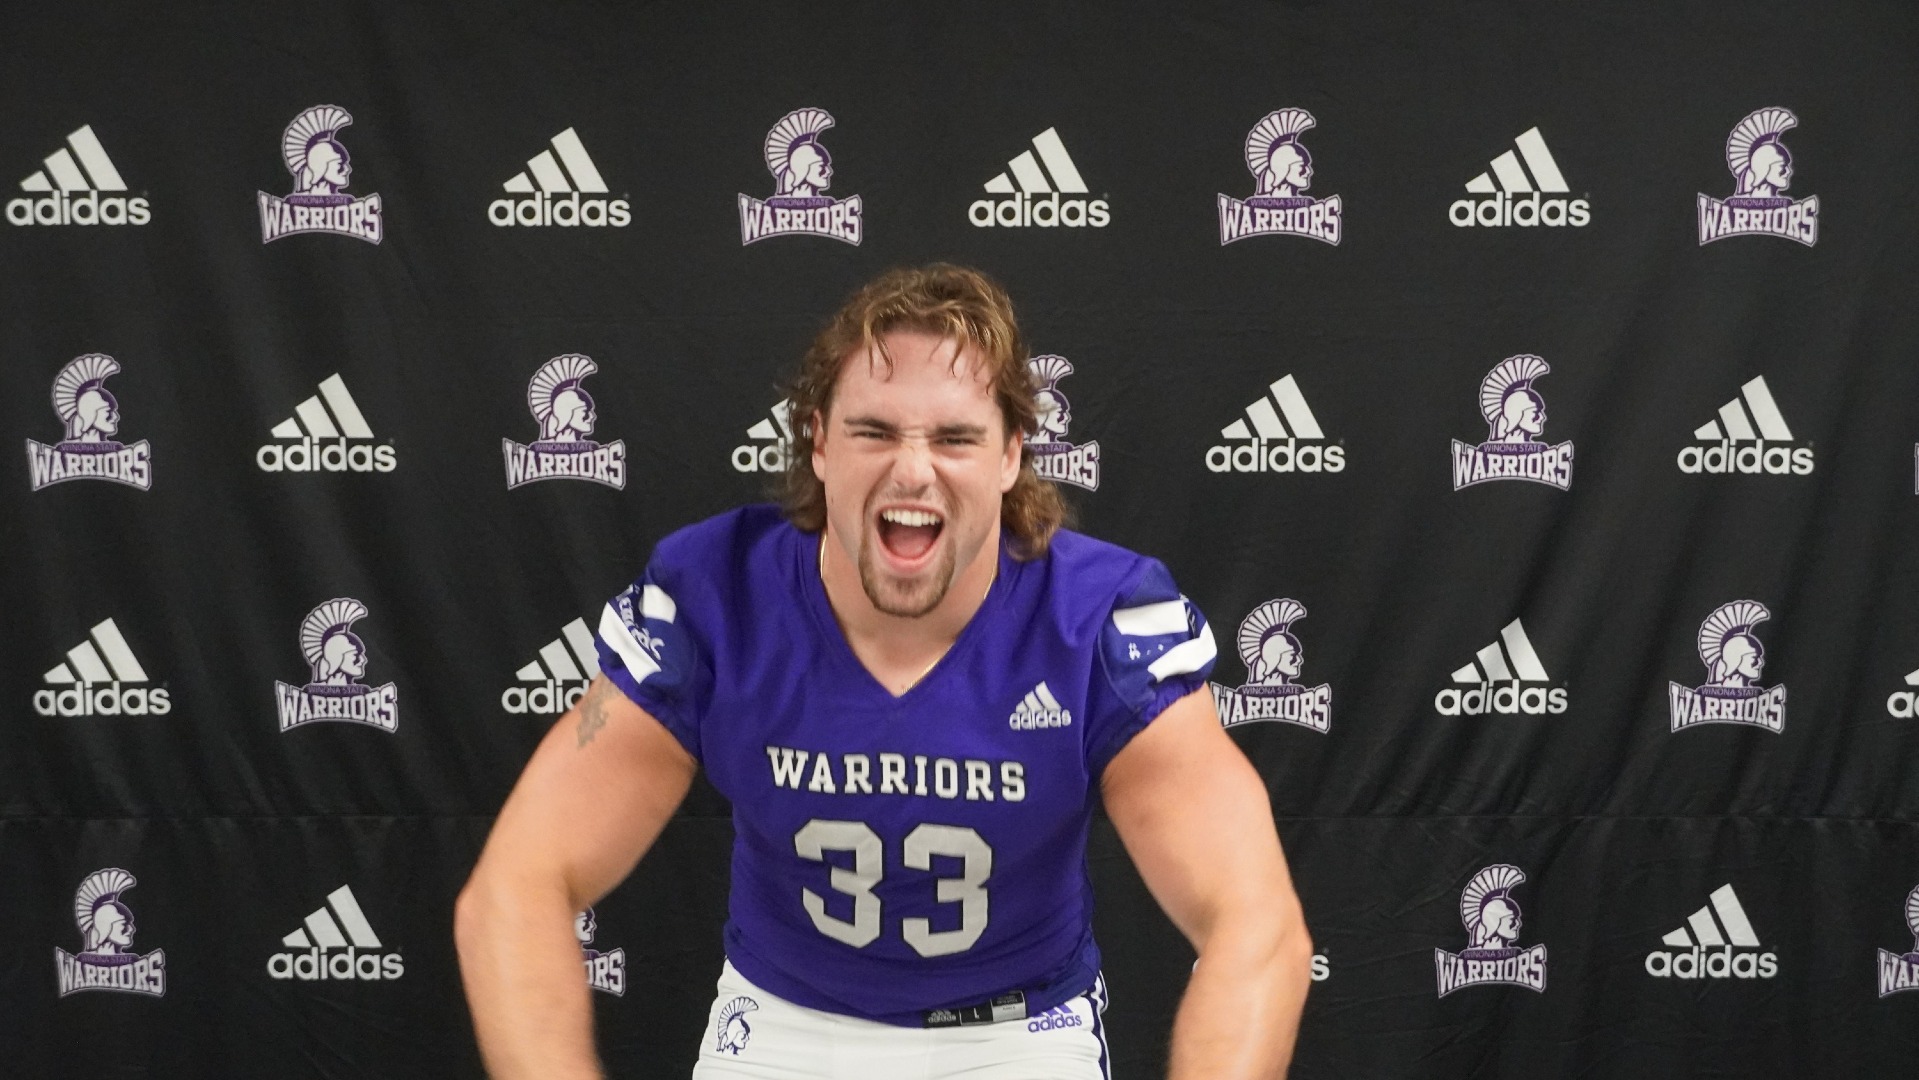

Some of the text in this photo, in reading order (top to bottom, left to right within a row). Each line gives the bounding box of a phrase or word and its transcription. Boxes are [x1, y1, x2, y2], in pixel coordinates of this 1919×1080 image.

[6, 190, 150, 225] adidas
[260, 194, 380, 241] WARRIORS
[290, 197, 348, 205] WINONA STATE
[488, 191, 631, 226] adidas
[771, 199, 829, 207] WINONA STATE
[969, 191, 1110, 227] adidas
[1250, 199, 1310, 207] WINONA STATE
[1449, 192, 1590, 227] adidas
[1730, 198, 1788, 207] WINONA STATE
[740, 196, 860, 243] WARRIORS
[1220, 196, 1340, 243] WARRIORS
[1699, 196, 1817, 243] WARRIORS
[30, 442, 149, 487] WARRIORS
[61, 443, 118, 452] WINONA STATE
[257, 437, 396, 472] adidas
[505, 441, 623, 487] WARRIORS
[536, 443, 593, 451] WINONA STATE
[1206, 438, 1345, 472] adidas
[1454, 442, 1571, 487] WARRIORS
[1483, 444, 1542, 453] WINONA STATE
[1677, 440, 1813, 475] adidas
[1032, 444, 1096, 487] RIORS
[34, 681, 171, 716] adidas
[277, 683, 396, 730] WARRIORS
[1212, 685, 1328, 730] WARRIORS
[1242, 686, 1299, 695] WINONA STATE
[1435, 680, 1567, 715] adidas
[1671, 685, 1784, 730] WARRIORS
[1701, 687, 1758, 696] WINONA STATE
[1009, 709, 1071, 731] adidas
[767, 746, 1025, 801] WARRIORS
[795, 818, 992, 958] 33
[59, 951, 163, 994] WARRIORS
[268, 946, 403, 979] adidas
[1438, 947, 1544, 995] WARRIORS
[1645, 945, 1777, 979] adidas
[1028, 1013, 1082, 1033] adidas
